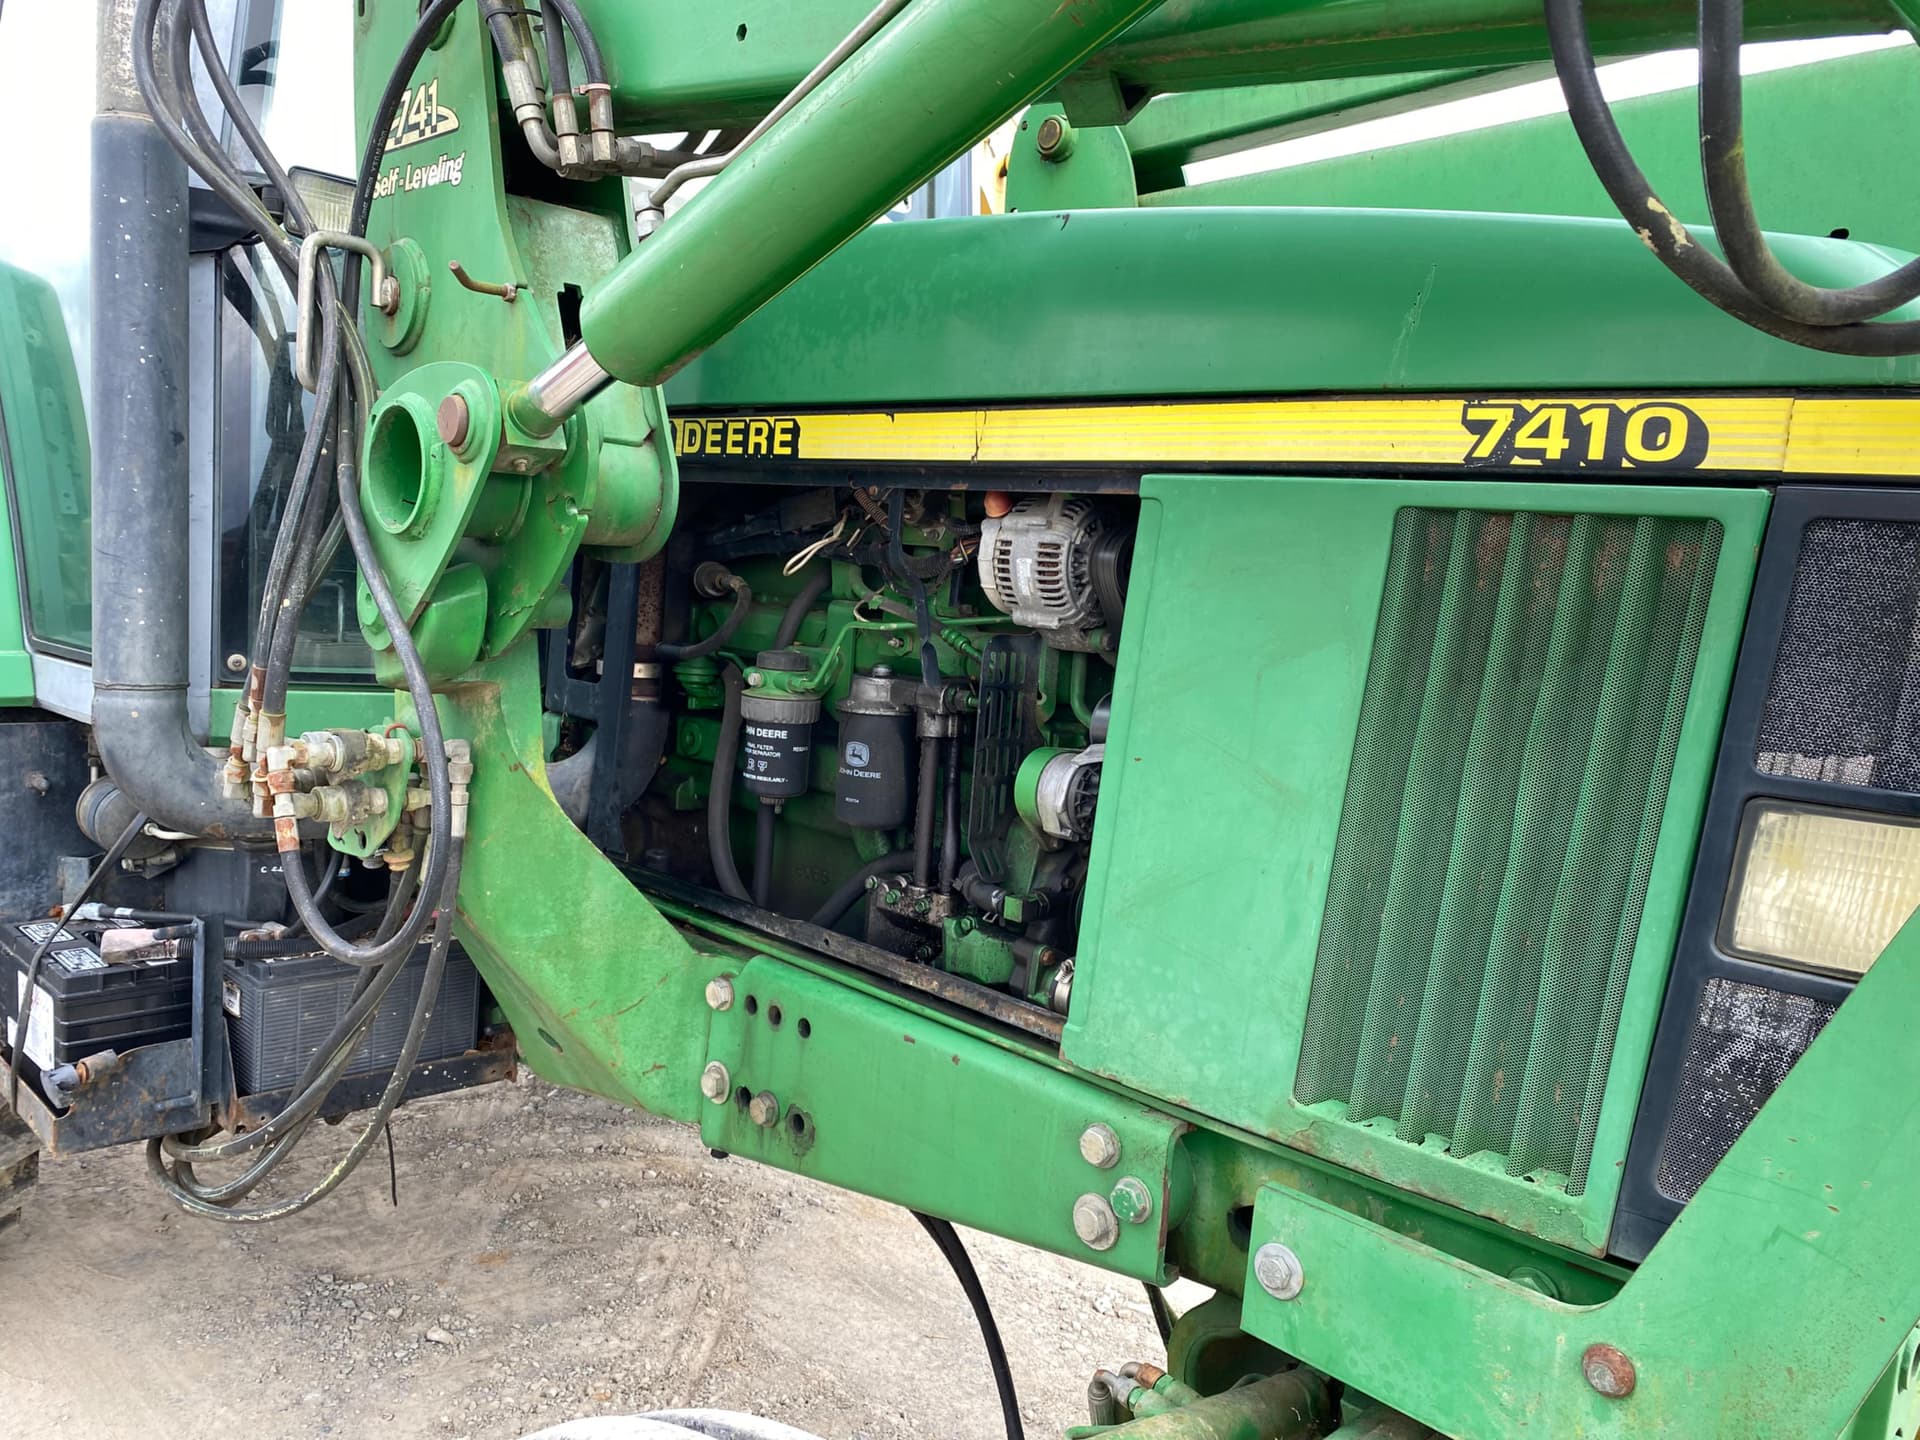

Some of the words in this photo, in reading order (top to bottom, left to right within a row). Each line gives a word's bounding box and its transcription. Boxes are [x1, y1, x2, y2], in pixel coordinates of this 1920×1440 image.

[394, 78, 439, 138] 741
[683, 419, 794, 456] DEERE
[1466, 406, 1689, 463] 7410
[756, 728, 788, 740] DEERE
[757, 743, 775, 751] FILTER
[752, 749, 781, 759] SEPARATOR
[854, 769, 882, 779] DEERE
